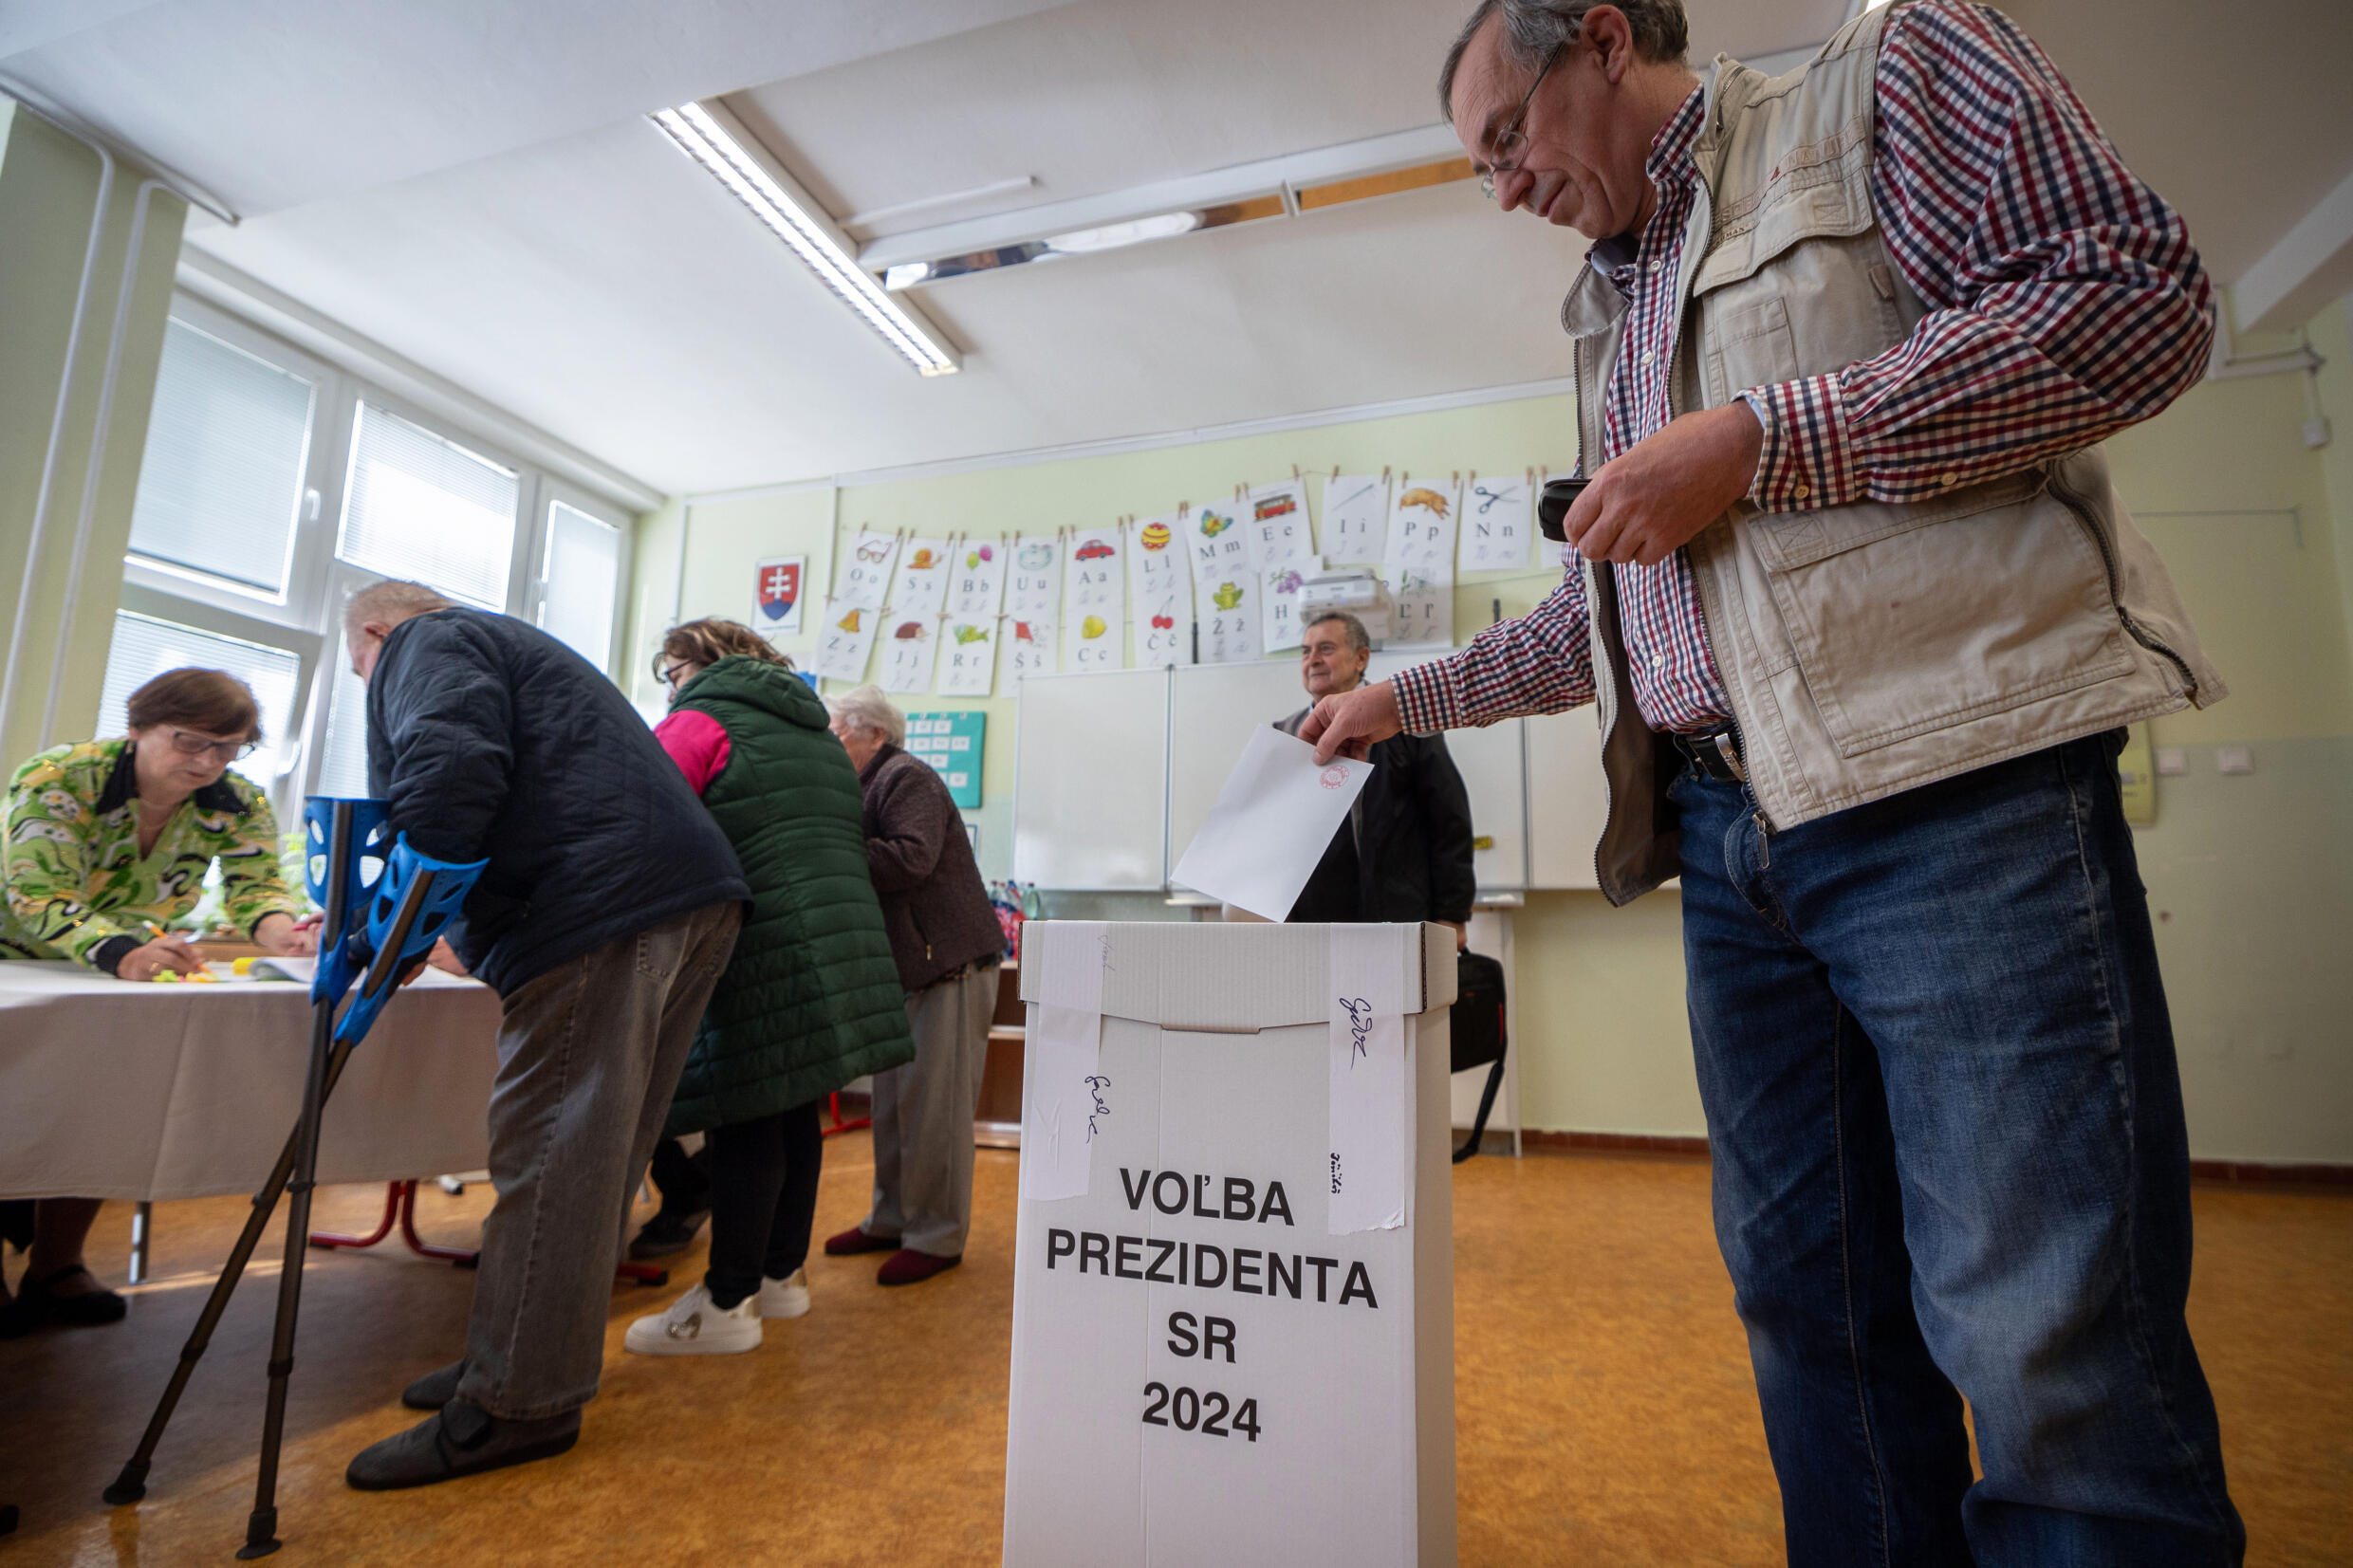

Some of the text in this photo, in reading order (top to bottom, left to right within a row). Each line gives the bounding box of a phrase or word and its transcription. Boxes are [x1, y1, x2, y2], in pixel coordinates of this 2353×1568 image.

[1360, 517, 1366, 533] i
[1404, 522, 1439, 541] P p
[1474, 523, 1513, 537] N n
[1262, 526, 1292, 541] E e
[1199, 541, 1241, 559] M m
[1143, 559, 1155, 573] L
[850, 568, 863, 581] O
[1078, 571, 1107, 584] A a
[907, 577, 933, 591] S s
[962, 580, 990, 592] B b
[1017, 577, 1047, 590] U u
[1274, 604, 1288, 619] H
[826, 636, 841, 650] Z
[1147, 633, 1159, 650] Č
[953, 654, 963, 666] R
[1078, 648, 1090, 661] C
[1120, 1169, 1294, 1226] VOĽBA
[1047, 1228, 1379, 1309] PREZIDENTA
[1168, 1312, 1235, 1363] SR
[1142, 1382, 1261, 1442] 2024
